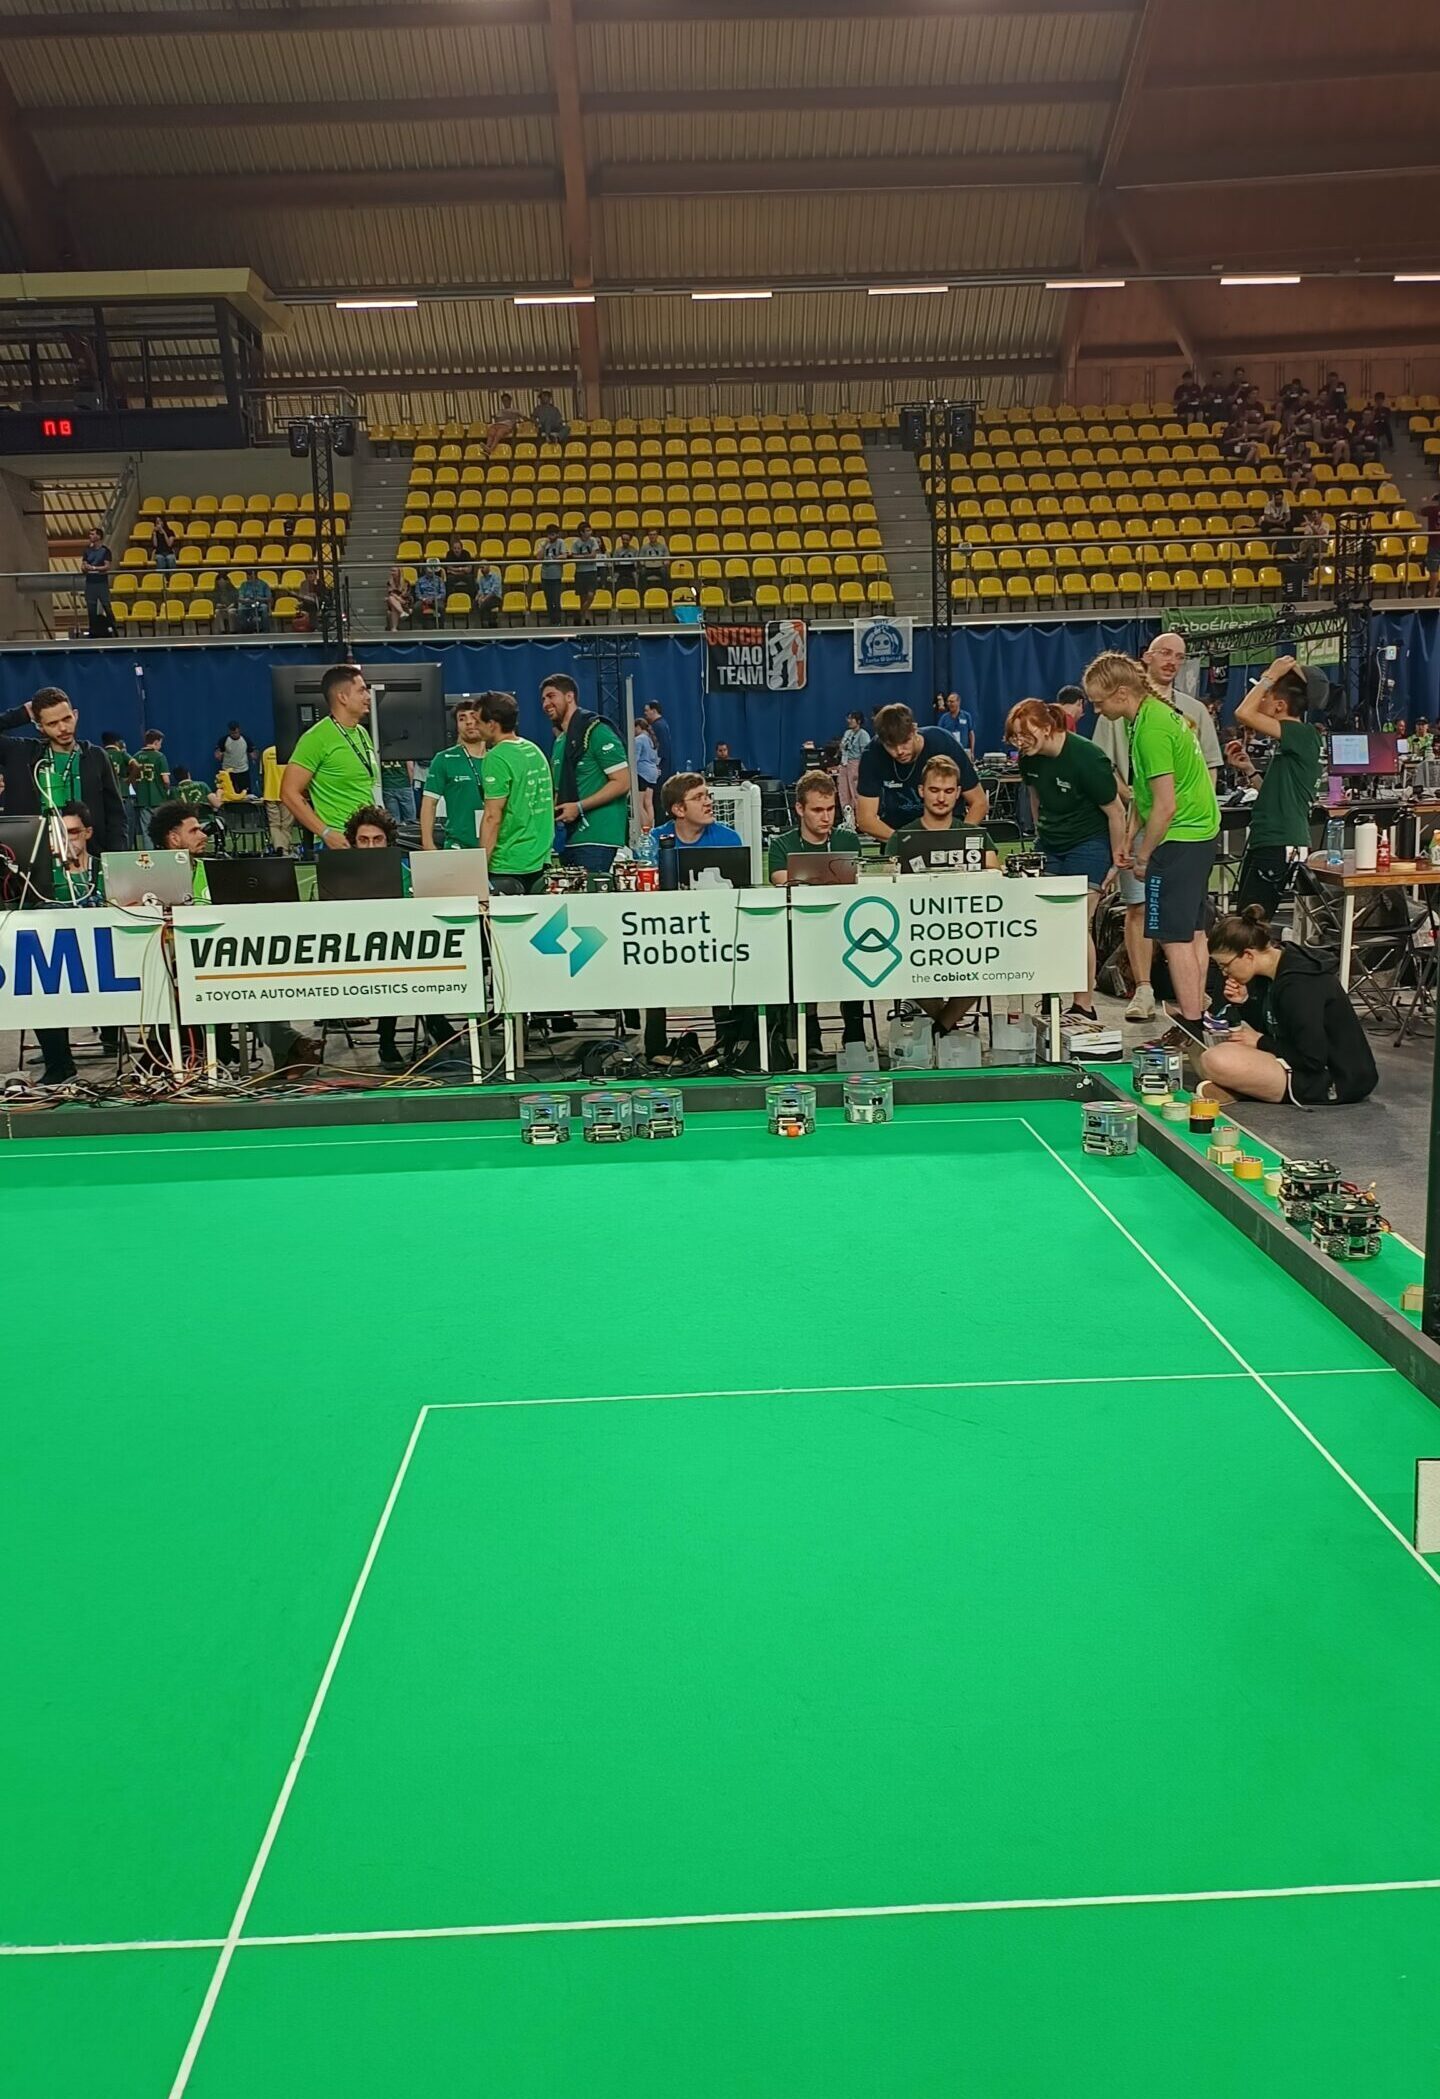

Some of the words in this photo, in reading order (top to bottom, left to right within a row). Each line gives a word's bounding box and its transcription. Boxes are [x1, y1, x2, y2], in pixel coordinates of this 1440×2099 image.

[706, 626, 763, 646] DUTCH
[727, 646, 763, 666] NAO
[717, 666, 764, 685] TEAM
[909, 895, 1004, 916] UNITED
[621, 911, 711, 936] Smart
[910, 919, 1038, 942] ROBOTICS
[190, 929, 466, 968] VANDERLANDE
[623, 938, 750, 966] Robotics
[909, 946, 1000, 967] GROUP
[0, 926, 142, 996] ML
[911, 973, 931, 984] the
[933, 971, 979, 983] CobiotX
[982, 970, 1035, 982] company
[195, 994, 203, 1003] a
[205, 989, 257, 1002] TOYOTA
[260, 985, 340, 999] AUTOMATED
[343, 983, 409, 997] LOGISTICS
[411, 983, 468, 995] company
